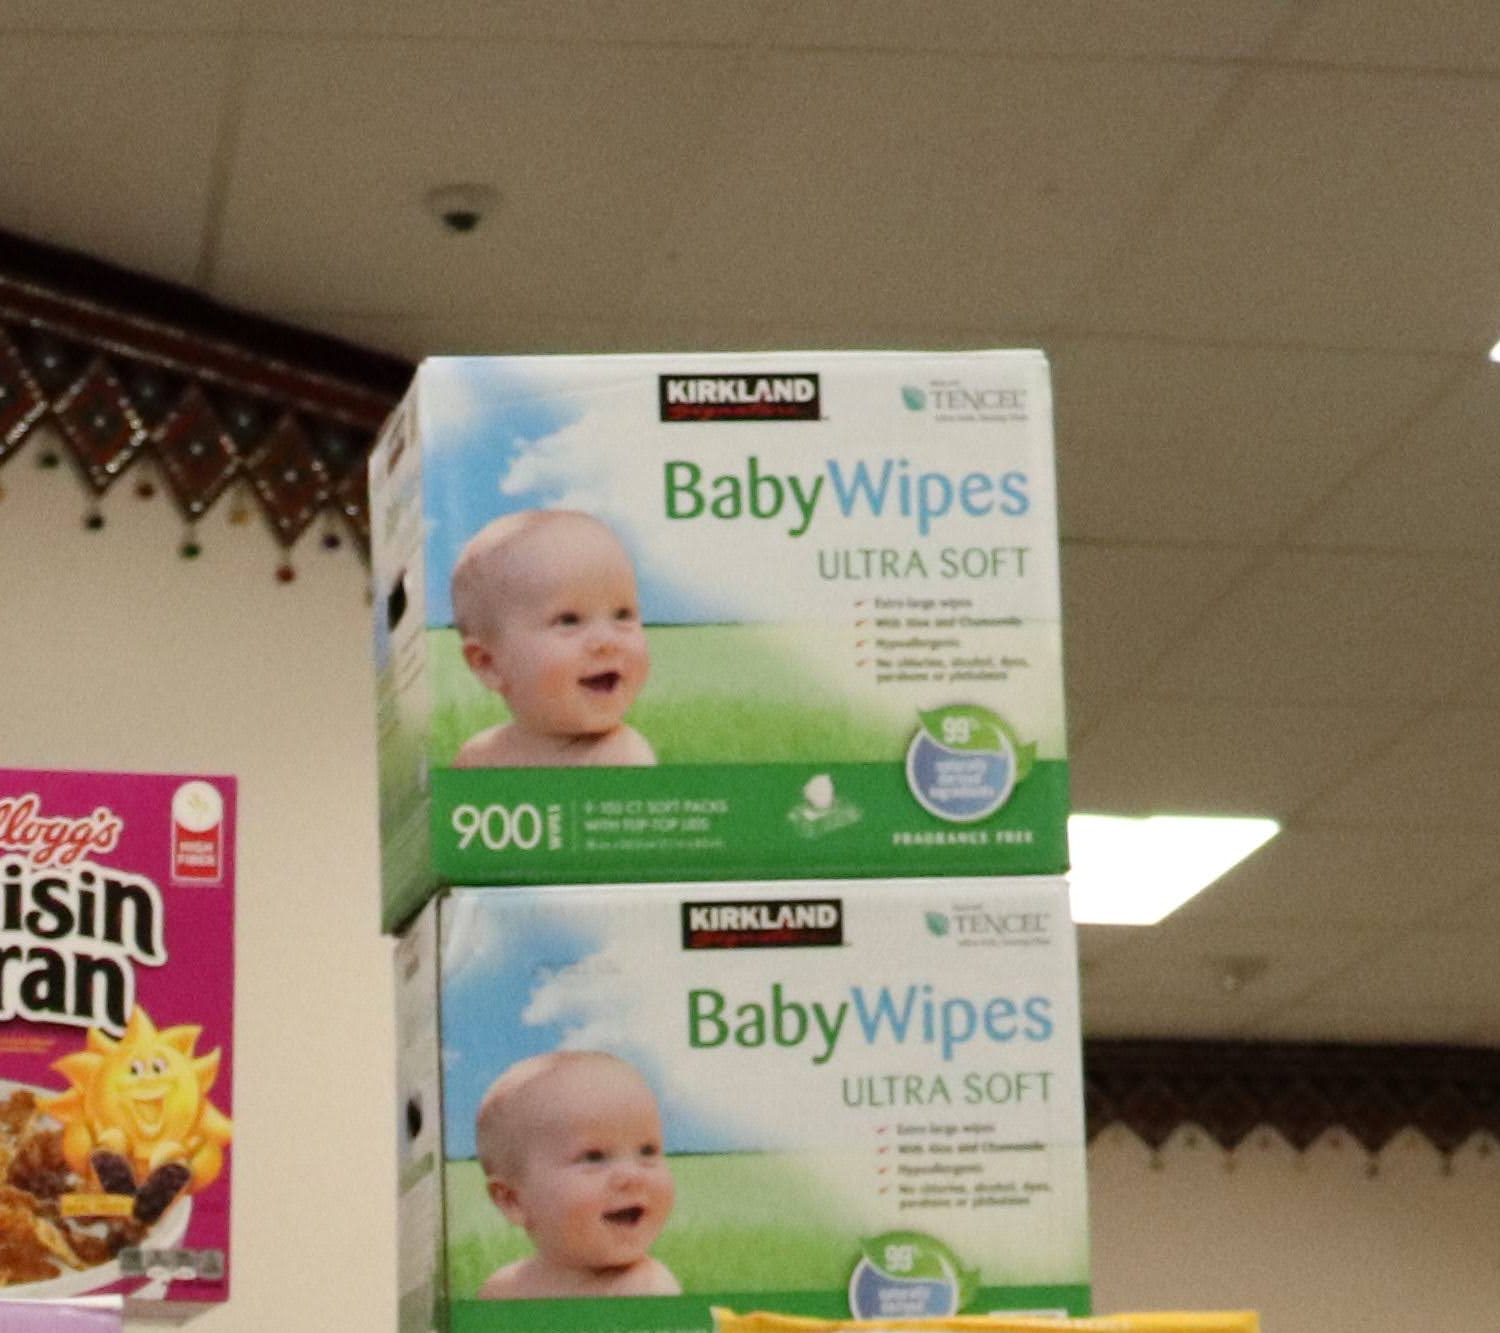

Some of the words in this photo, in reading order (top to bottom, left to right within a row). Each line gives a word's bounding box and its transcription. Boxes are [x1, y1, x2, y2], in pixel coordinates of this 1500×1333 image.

[668, 378, 814, 404] KIRKLAND
[931, 389, 1022, 411] TENCEL
[819, 548, 927, 582] ULTRA
[941, 545, 1029, 580] SOFT
[452, 803, 543, 851] 900
[690, 905, 839, 931] KIRKLAND
[955, 913, 1046, 934] TENCEL
[843, 1075, 947, 1108] ULTRA
[963, 1071, 1054, 1106] SOFT
